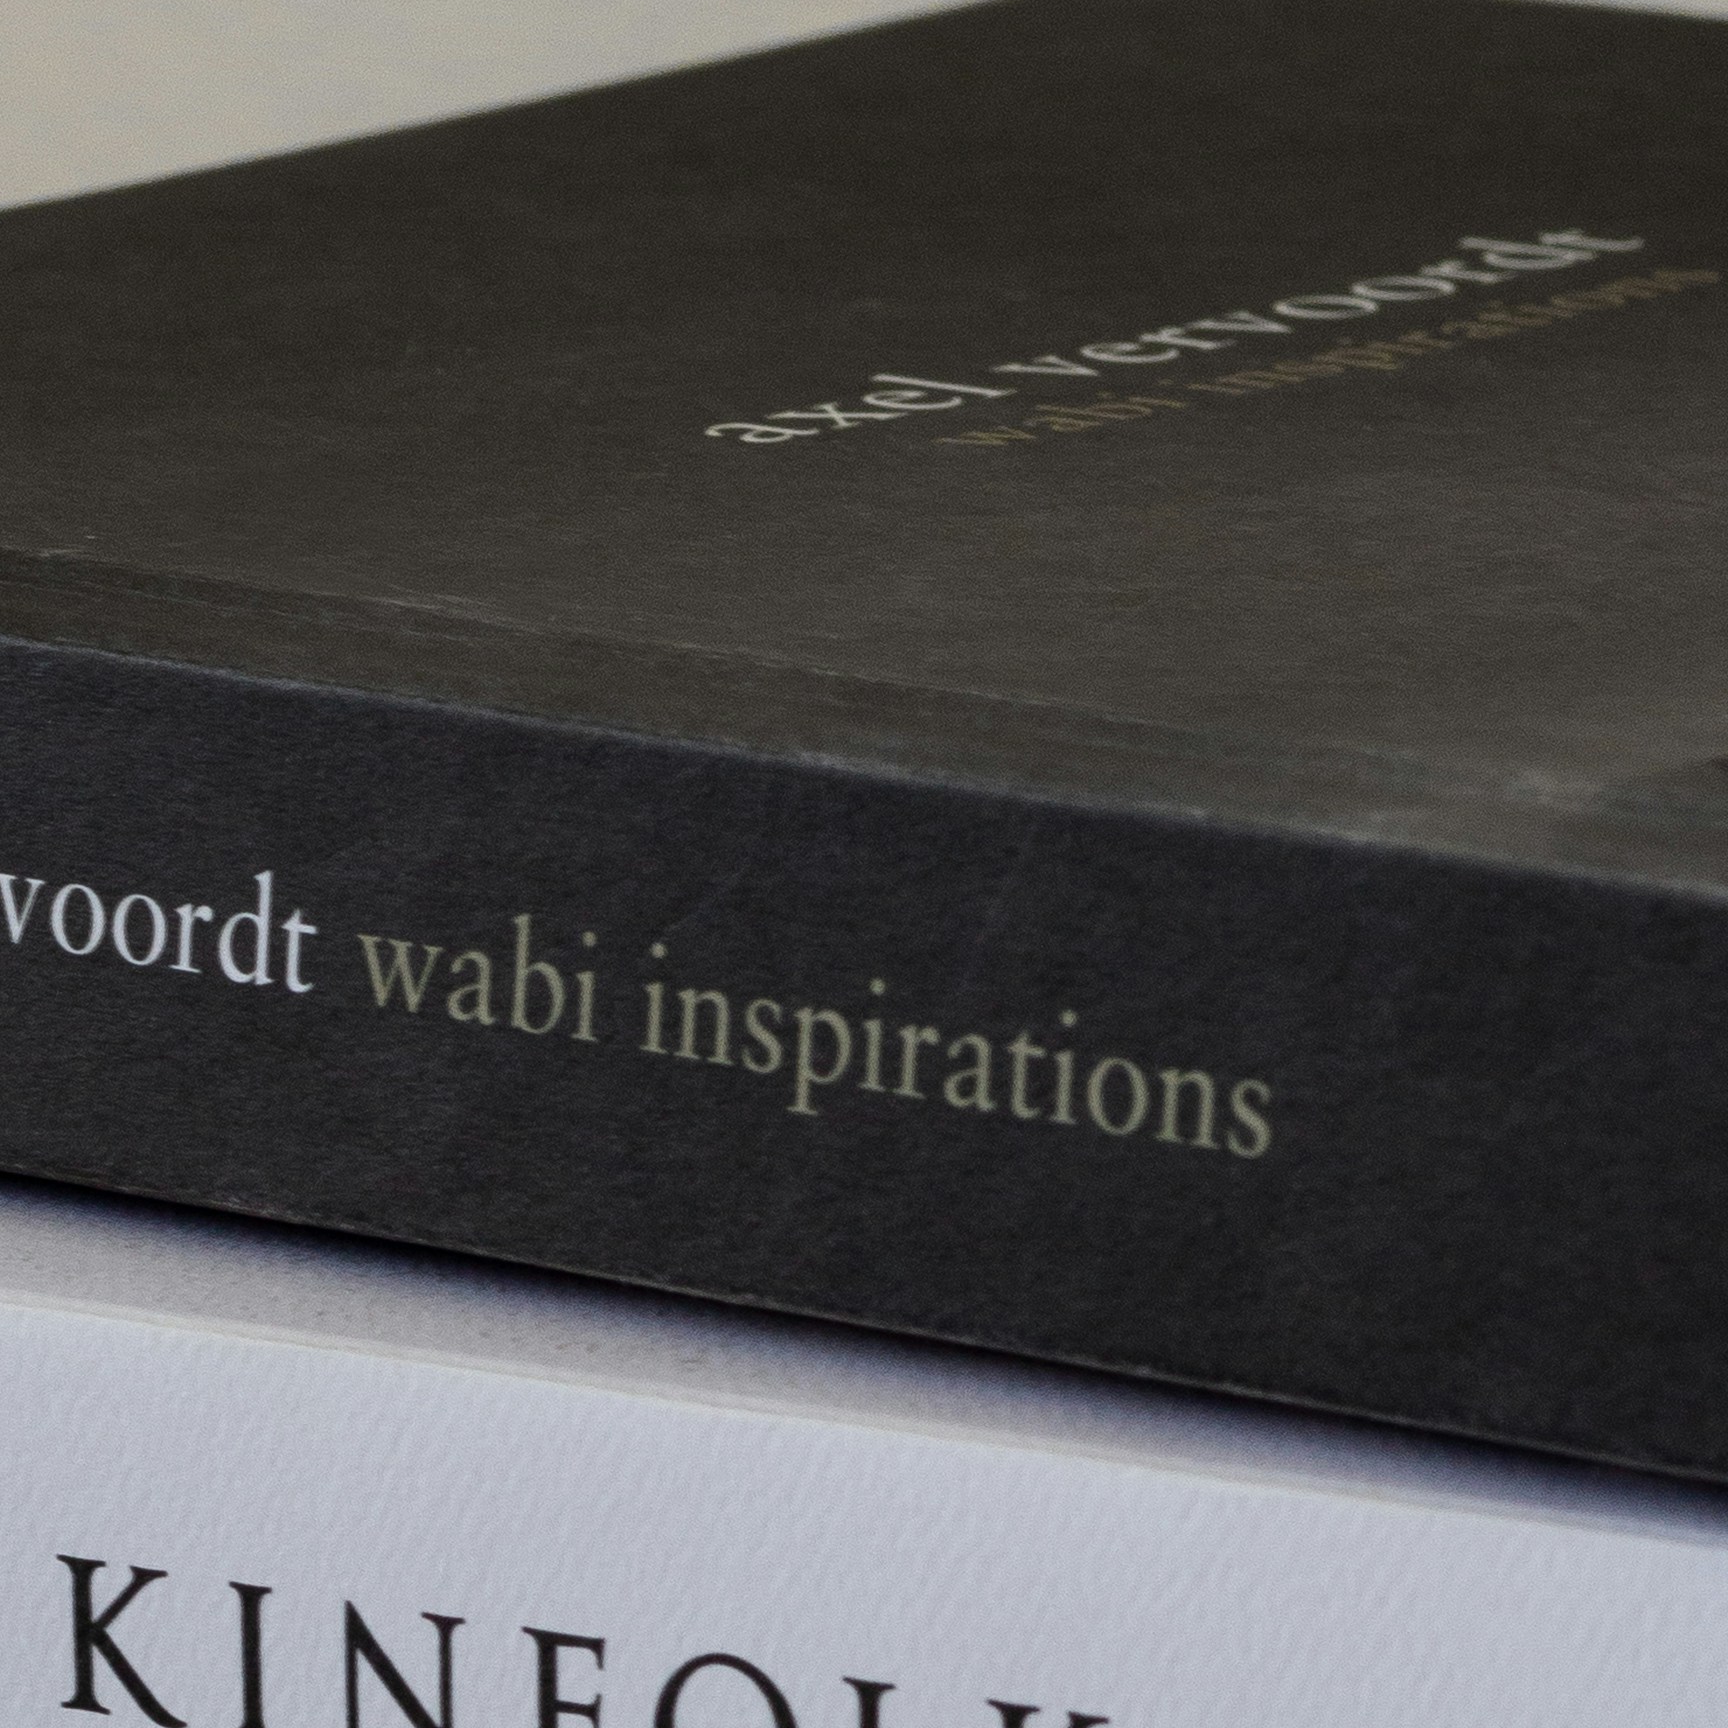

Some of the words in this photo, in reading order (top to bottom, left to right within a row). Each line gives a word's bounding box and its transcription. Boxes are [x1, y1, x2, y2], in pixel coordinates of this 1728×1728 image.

[704, 374, 1016, 444] axel
[992, 229, 1646, 379] vervoordt
[358, 913, 598, 1042] wabi
[640, 940, 1272, 1159] inspirations
